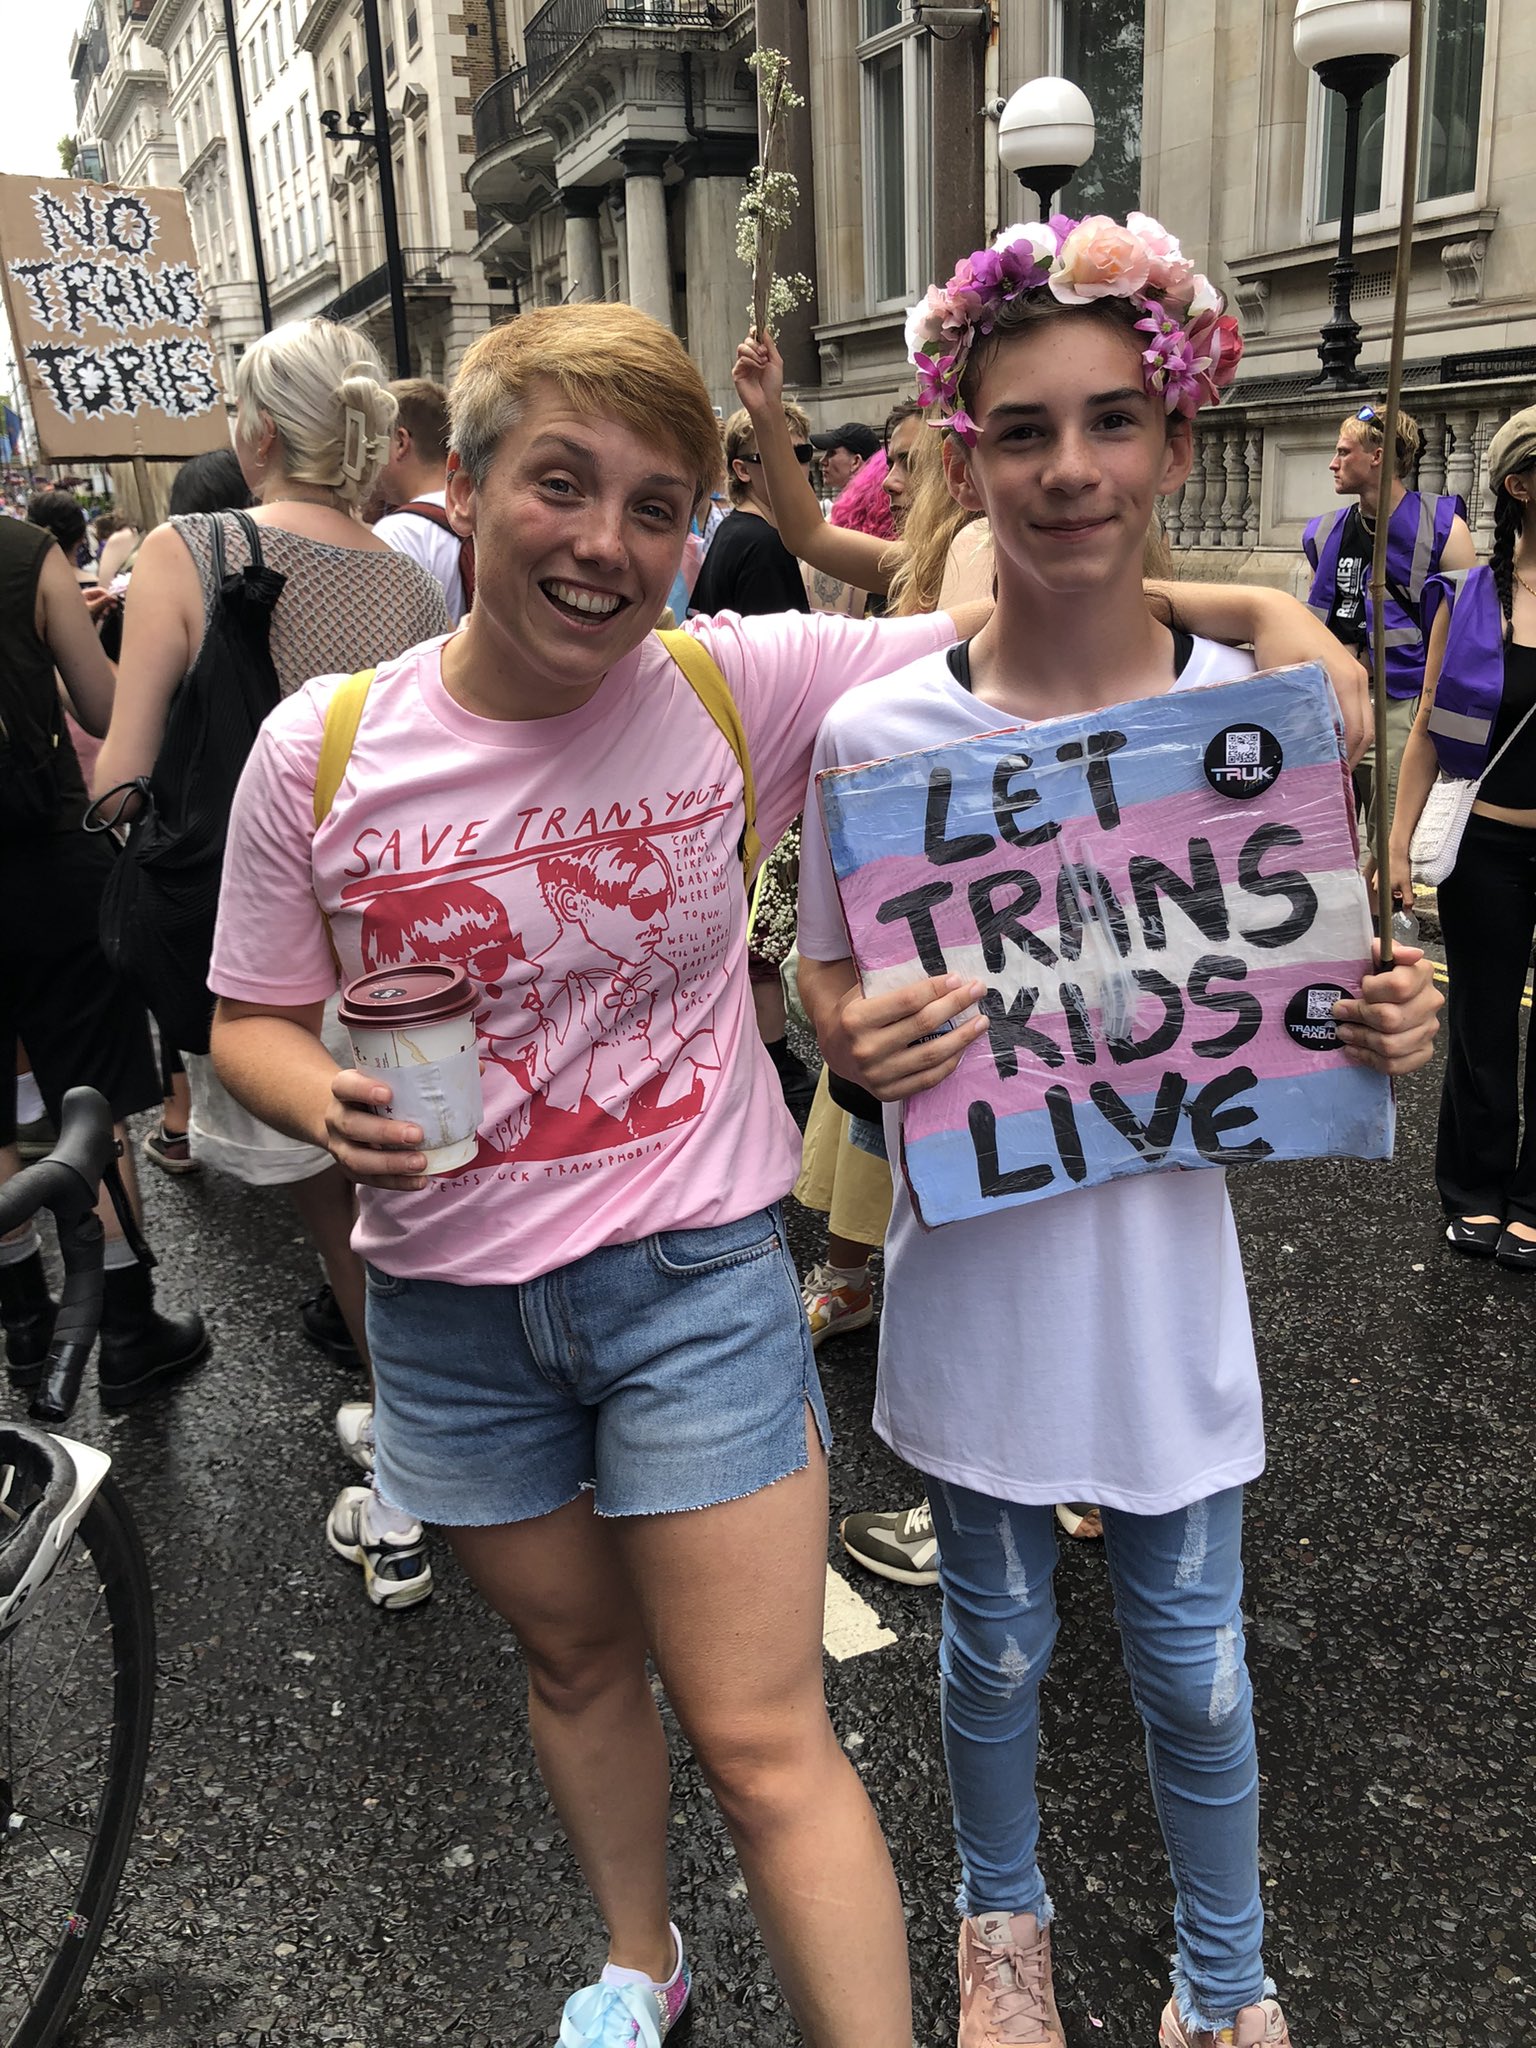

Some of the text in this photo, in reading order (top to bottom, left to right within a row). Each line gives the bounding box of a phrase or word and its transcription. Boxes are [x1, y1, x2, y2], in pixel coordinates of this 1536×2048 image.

[29, 187, 161, 263] NO
[9, 256, 207, 337] TRANS
[25, 335, 220, 424] TORIES
[1336, 557, 1353, 618] ROKIES
[1210, 765, 1274, 782] TRUK
[923, 730, 1128, 865] LET
[344, 782, 726, 878] SAVE TRANS YOUTH
[673, 842, 709, 860] TRANS
[676, 857, 702, 872] LIKE
[677, 871, 708, 888] BABY
[679, 889, 708, 904] WERE
[875, 822, 1318, 978] TRANS
[683, 910, 698, 921] TO
[693, 943, 705, 953] WE
[681, 989, 697, 999] GO
[978, 954, 1263, 1081] KIDS
[1289, 1024, 1327, 1033] TRANS
[1301, 1031, 1336, 1040] RADIO
[967, 1065, 1275, 1197] LIVE
